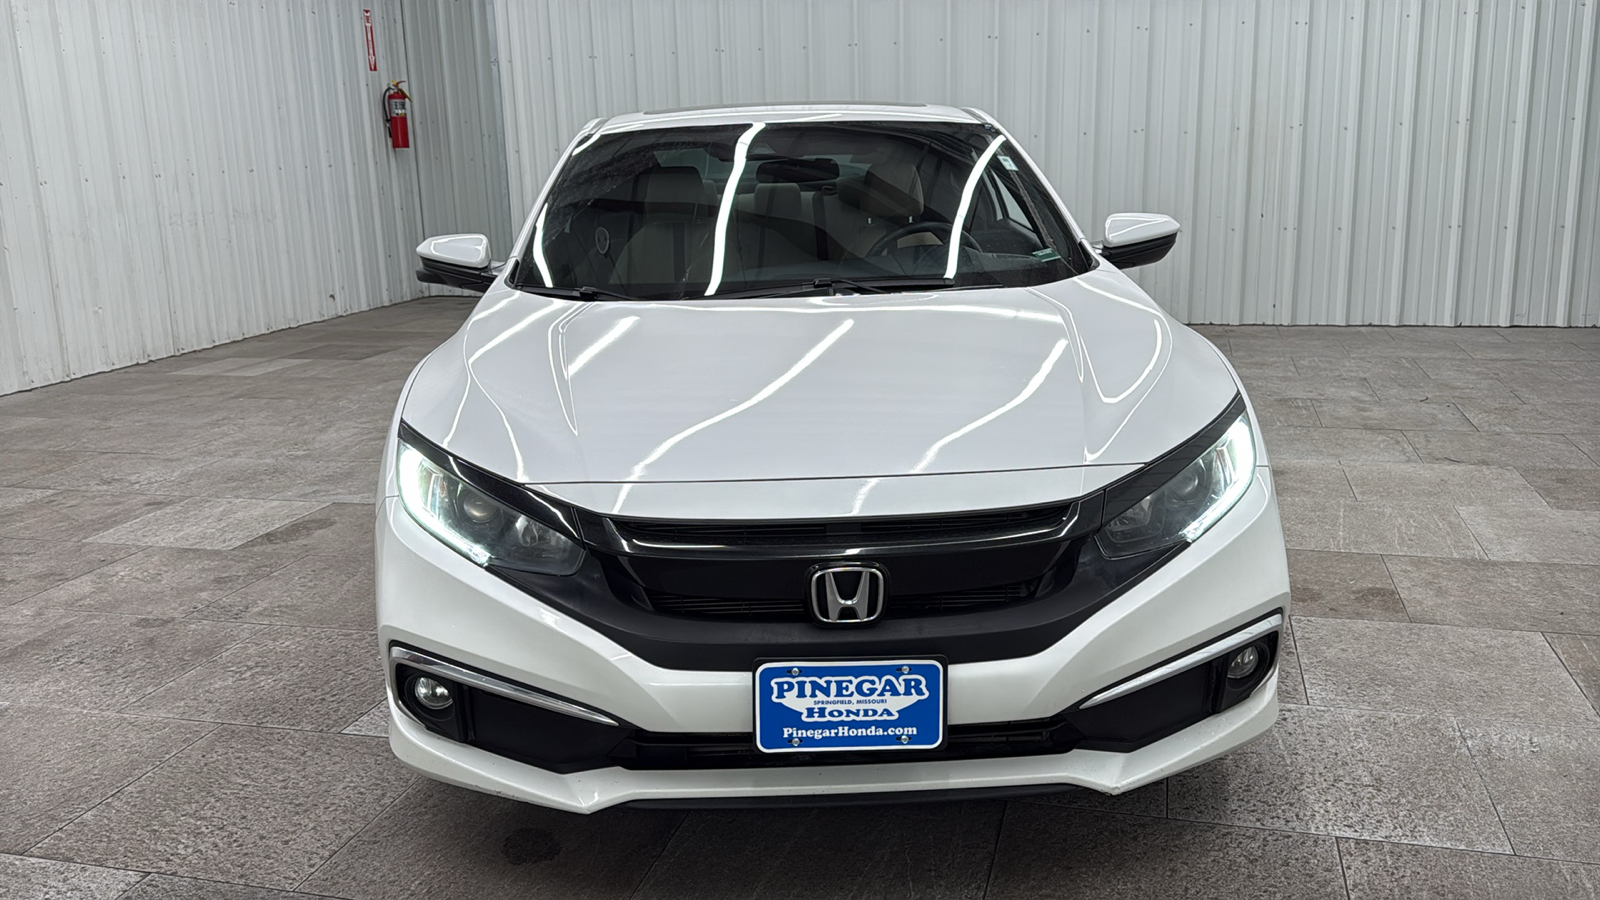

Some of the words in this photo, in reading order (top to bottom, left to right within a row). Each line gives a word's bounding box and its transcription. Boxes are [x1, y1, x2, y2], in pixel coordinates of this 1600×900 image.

[774, 678, 926, 699] PINEGAR
[805, 707, 895, 719] HONDA
[783, 726, 917, 739] PinegarHonda.com
